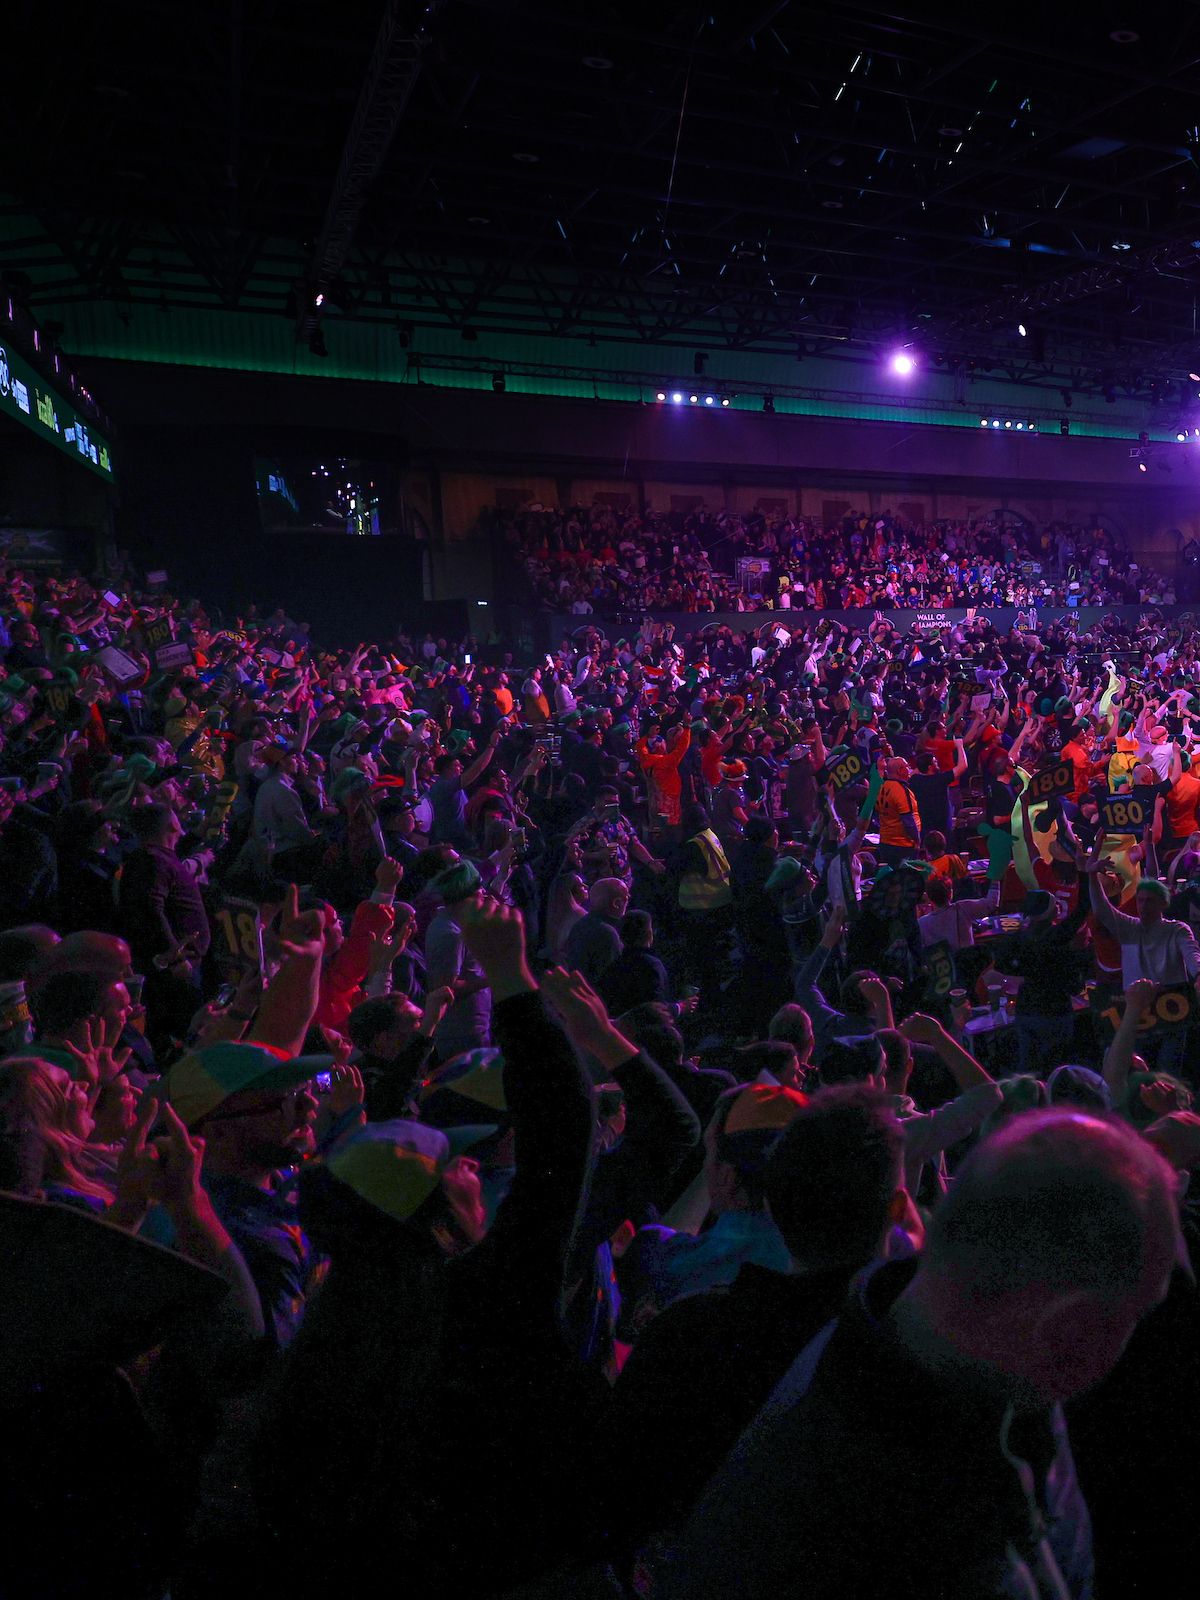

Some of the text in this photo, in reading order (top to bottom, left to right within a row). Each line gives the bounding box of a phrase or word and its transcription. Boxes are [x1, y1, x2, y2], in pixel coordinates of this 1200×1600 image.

[911, 621, 952, 629] CAMPIONS
[917, 613, 945, 621] WALL OF
[831, 755, 861, 789] 180
[1032, 767, 1070, 796] 180
[1102, 801, 1143, 827] 180
